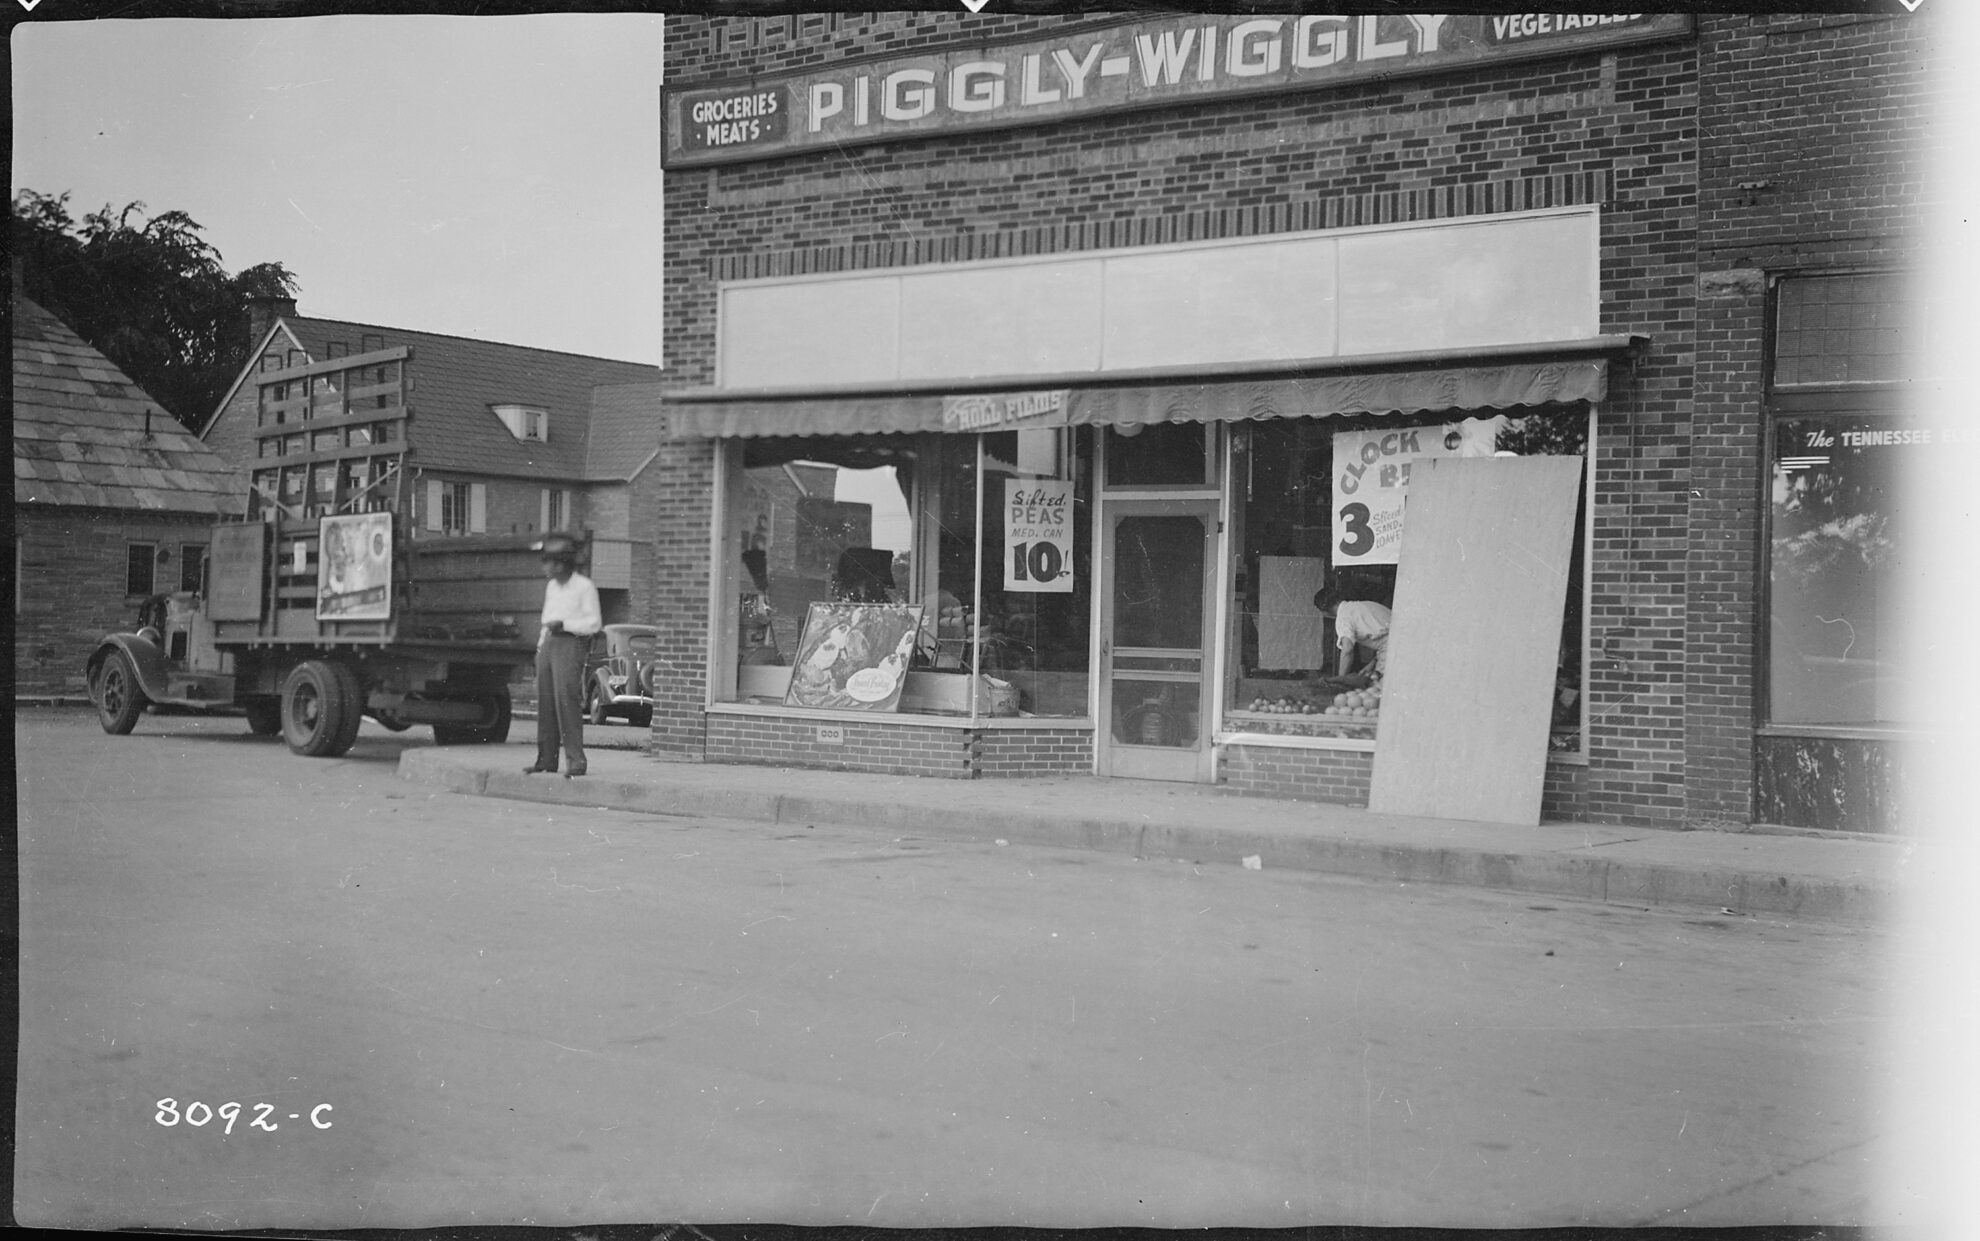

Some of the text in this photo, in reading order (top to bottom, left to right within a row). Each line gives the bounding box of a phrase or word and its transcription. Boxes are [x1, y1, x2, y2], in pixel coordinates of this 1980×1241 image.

[1493, 13, 1643, 40] VEGETAB
[809, 14, 1448, 133] PIGGLY-WIGGLY
[692, 91, 778, 123] GROCERIES
[706, 118, 761, 146] MEATS
[1004, 391, 1061, 422] FILMS
[1806, 429, 1835, 447] The
[1841, 429, 1932, 447] TENNESSEE
[1340, 430, 1421, 495] CLOCK
[1011, 507, 1064, 524] PEAS
[1339, 502, 1375, 556] 3
[1012, 528, 1064, 538] MED. CAN
[1376, 529, 1402, 548] LOAVE
